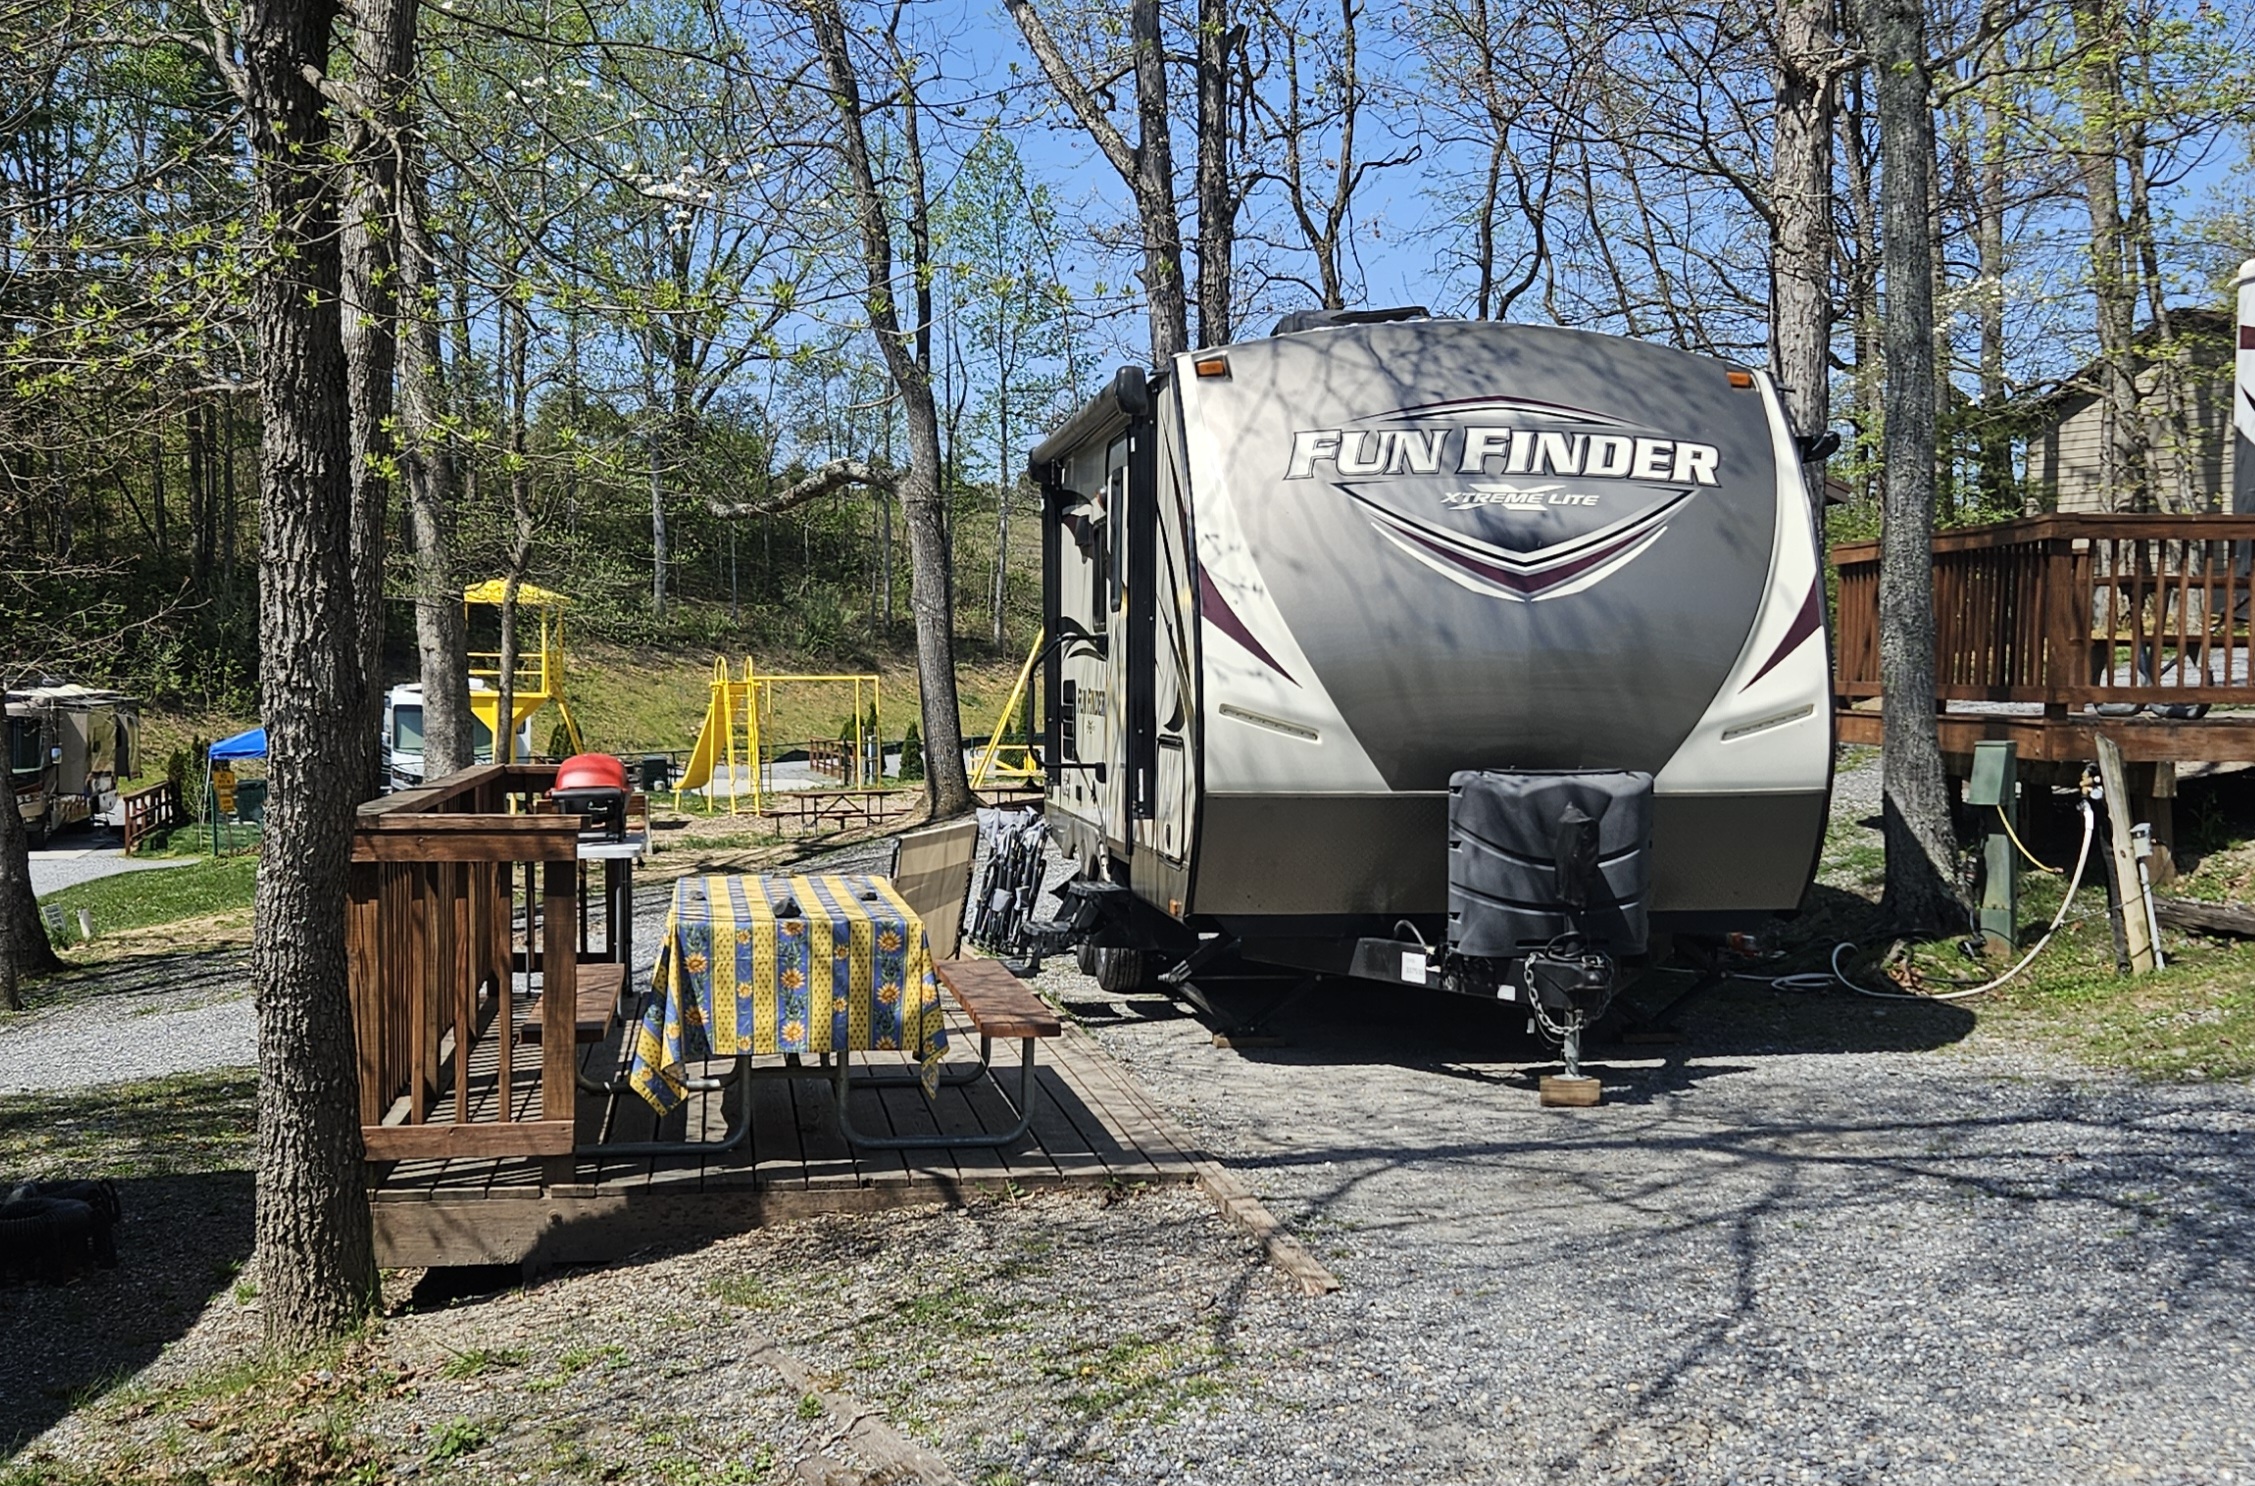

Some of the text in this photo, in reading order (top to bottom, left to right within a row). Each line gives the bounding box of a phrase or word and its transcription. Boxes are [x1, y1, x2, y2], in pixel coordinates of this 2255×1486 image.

[1282, 426, 1722, 488] FUN FINDER
[1440, 492, 1600, 506] XTREME LITE
